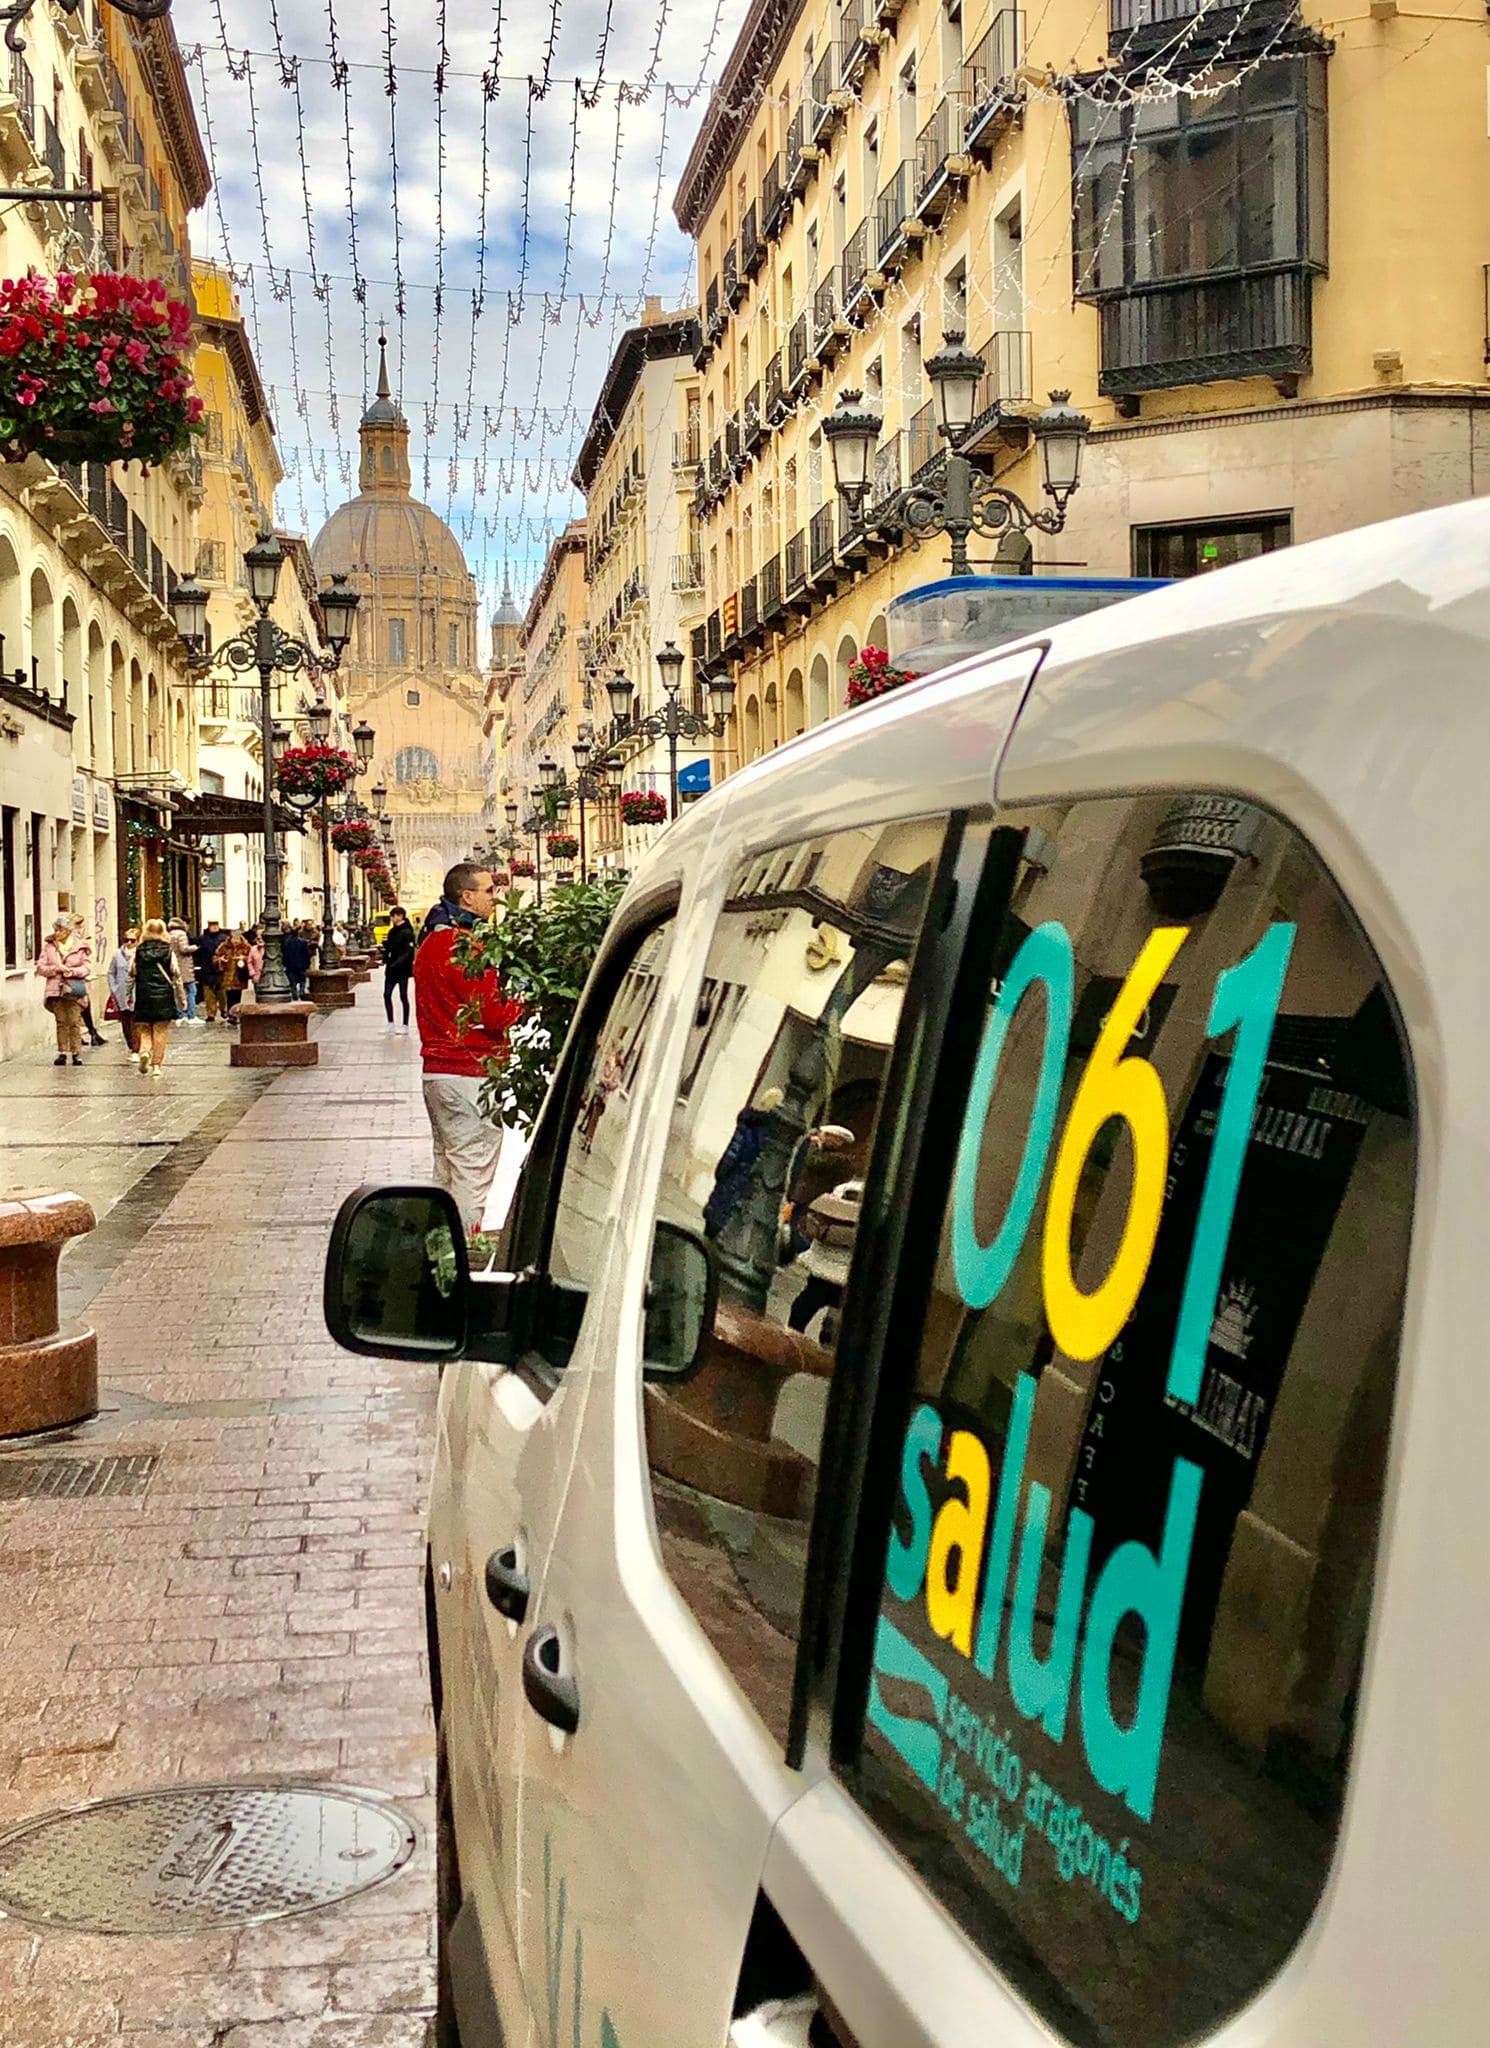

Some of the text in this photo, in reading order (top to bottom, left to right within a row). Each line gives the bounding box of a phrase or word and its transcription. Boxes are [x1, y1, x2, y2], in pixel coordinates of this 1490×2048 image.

[952, 921, 1297, 1405] 061
[886, 1371, 1204, 1823] salud
[939, 1753, 1026, 1888] de salud
[946, 1693, 1142, 1923] servicio aragonés
